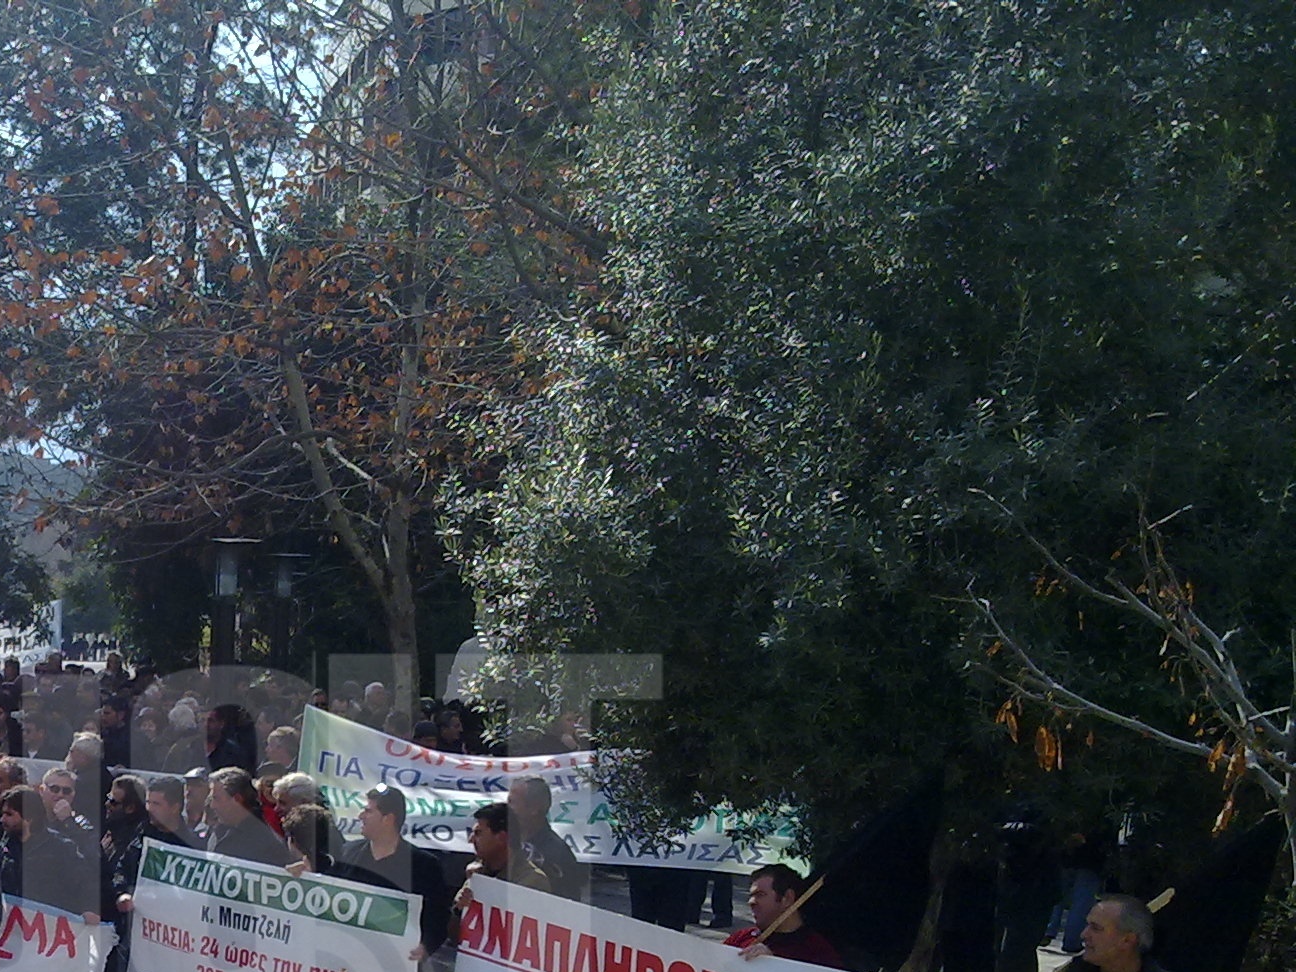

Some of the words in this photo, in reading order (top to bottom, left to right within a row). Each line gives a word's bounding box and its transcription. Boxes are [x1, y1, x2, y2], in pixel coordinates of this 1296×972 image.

[318, 751, 364, 781] ΓΙΑ
[160, 854, 373, 927] ΚΤΗΝΟΤΡΟΦΟΙ
[141, 918, 195, 953] ΕΡΓΑΣΙΑ:
[200, 936, 219, 958] 24
[219, 906, 292, 944] Μπατζελή
